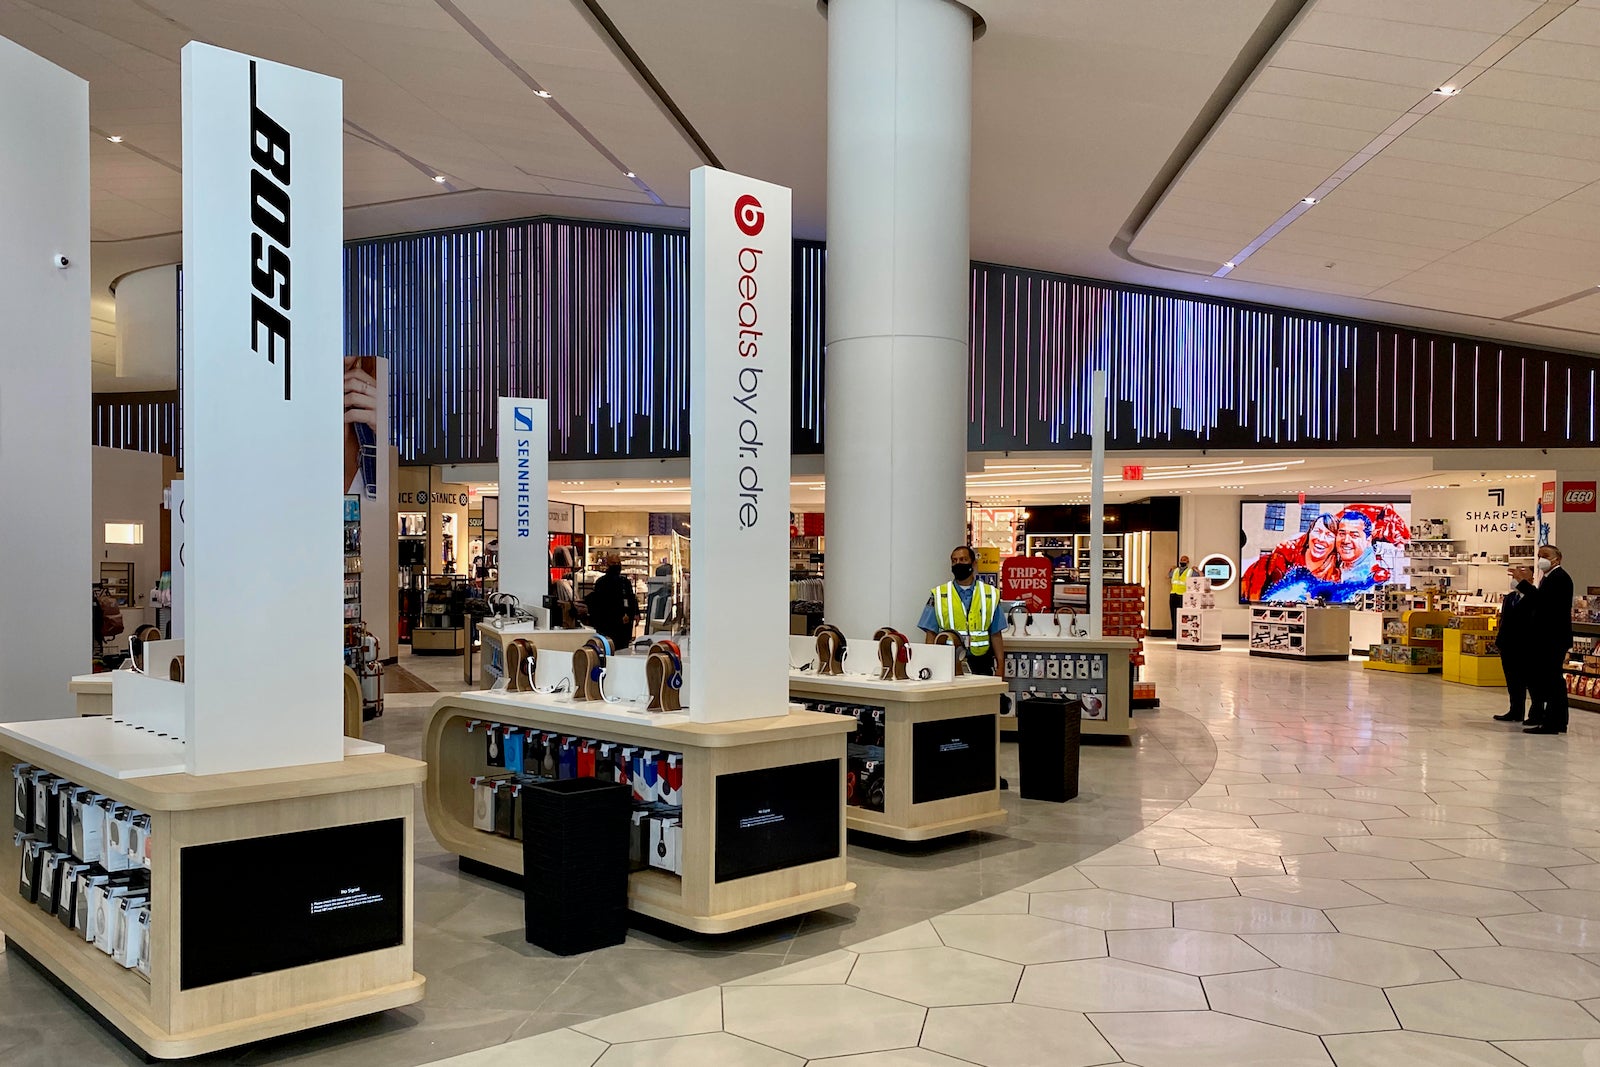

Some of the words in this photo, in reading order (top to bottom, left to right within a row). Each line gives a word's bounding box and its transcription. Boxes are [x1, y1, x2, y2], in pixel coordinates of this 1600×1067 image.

[249, 59, 292, 401] BOSE
[738, 247, 763, 357] beats
[733, 367, 763, 414] by
[431, 492, 457, 504] STANCE
[517, 439, 530, 538] SENNHEISER
[738, 466, 763, 528] dre
[1565, 490, 1595, 503] LEGO
[1466, 510, 1527, 520] SHARPER
[1008, 567, 1038, 578] TRIP
[1008, 578, 1048, 590] WIPES
